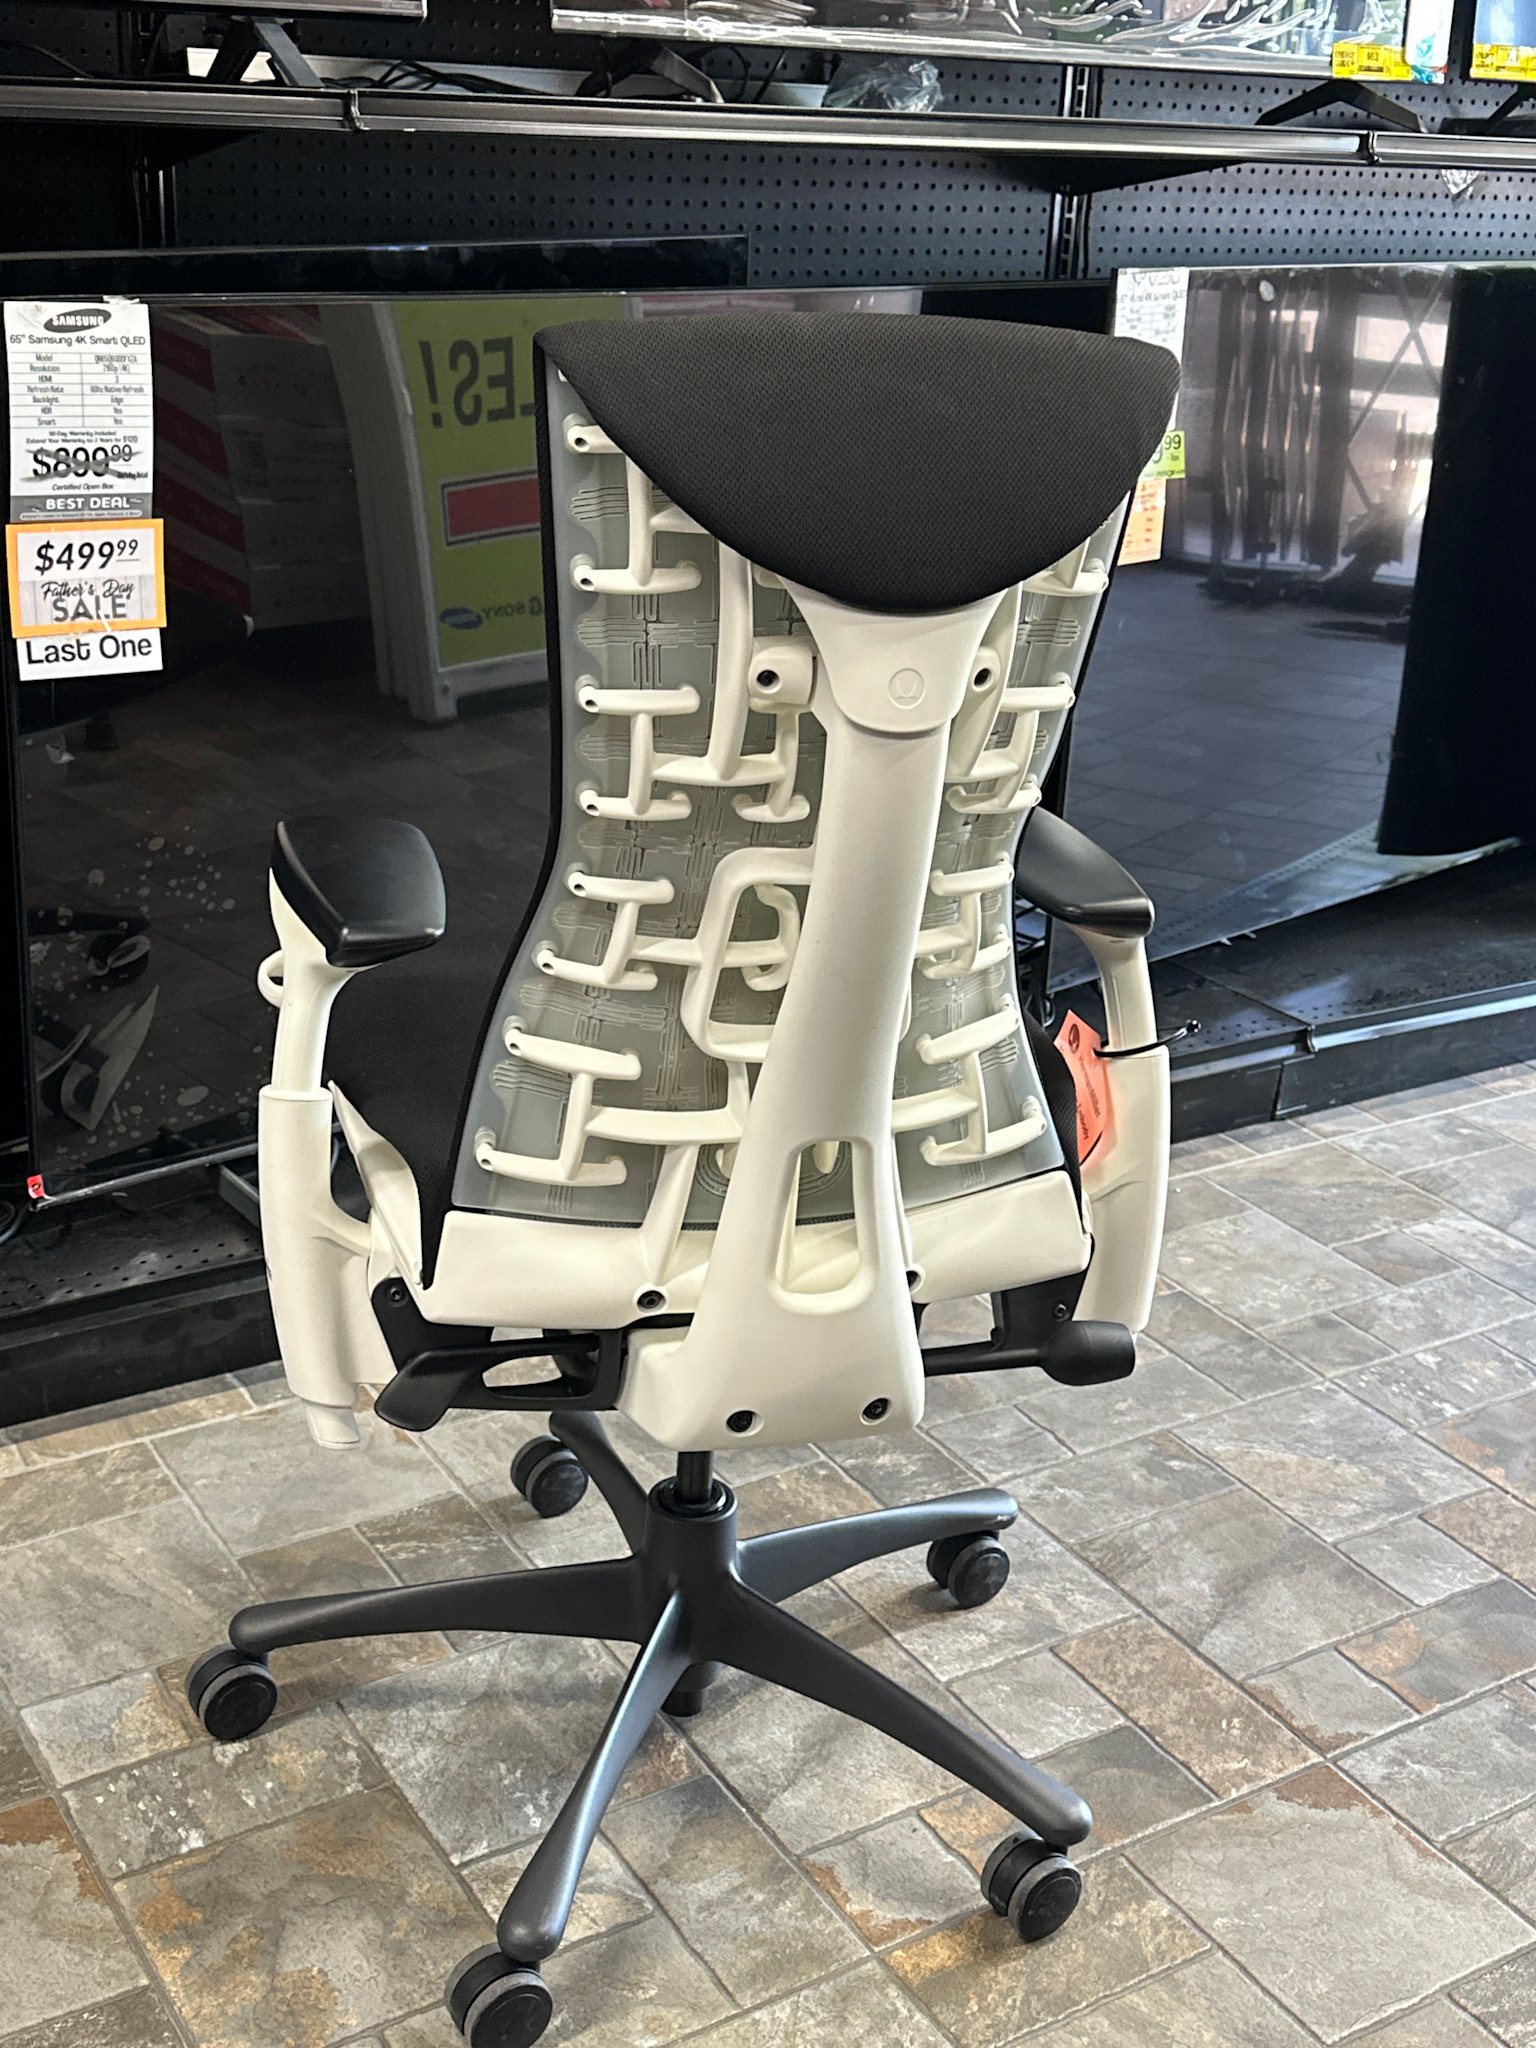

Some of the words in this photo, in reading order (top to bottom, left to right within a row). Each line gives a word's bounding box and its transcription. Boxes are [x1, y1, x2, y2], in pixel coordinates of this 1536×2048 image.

[51, 315, 105, 327] SAMSUNG
[10, 335, 26, 345] 65"
[28, 335, 72, 347] Samsung
[74, 336, 87, 345] 4K
[89, 336, 118, 345] Smart
[120, 336, 146, 346] QLED
[35, 354, 53, 362] Model
[83, 483, 101, 491] Open
[46, 498, 85, 510] BEST
[89, 496, 130, 509] DEAL
[41, 581, 96, 601] Father's
[102, 578, 135, 600] Day
[52, 594, 127, 623] SALE
[26, 638, 91, 665] Last
[99, 634, 152, 660] One
